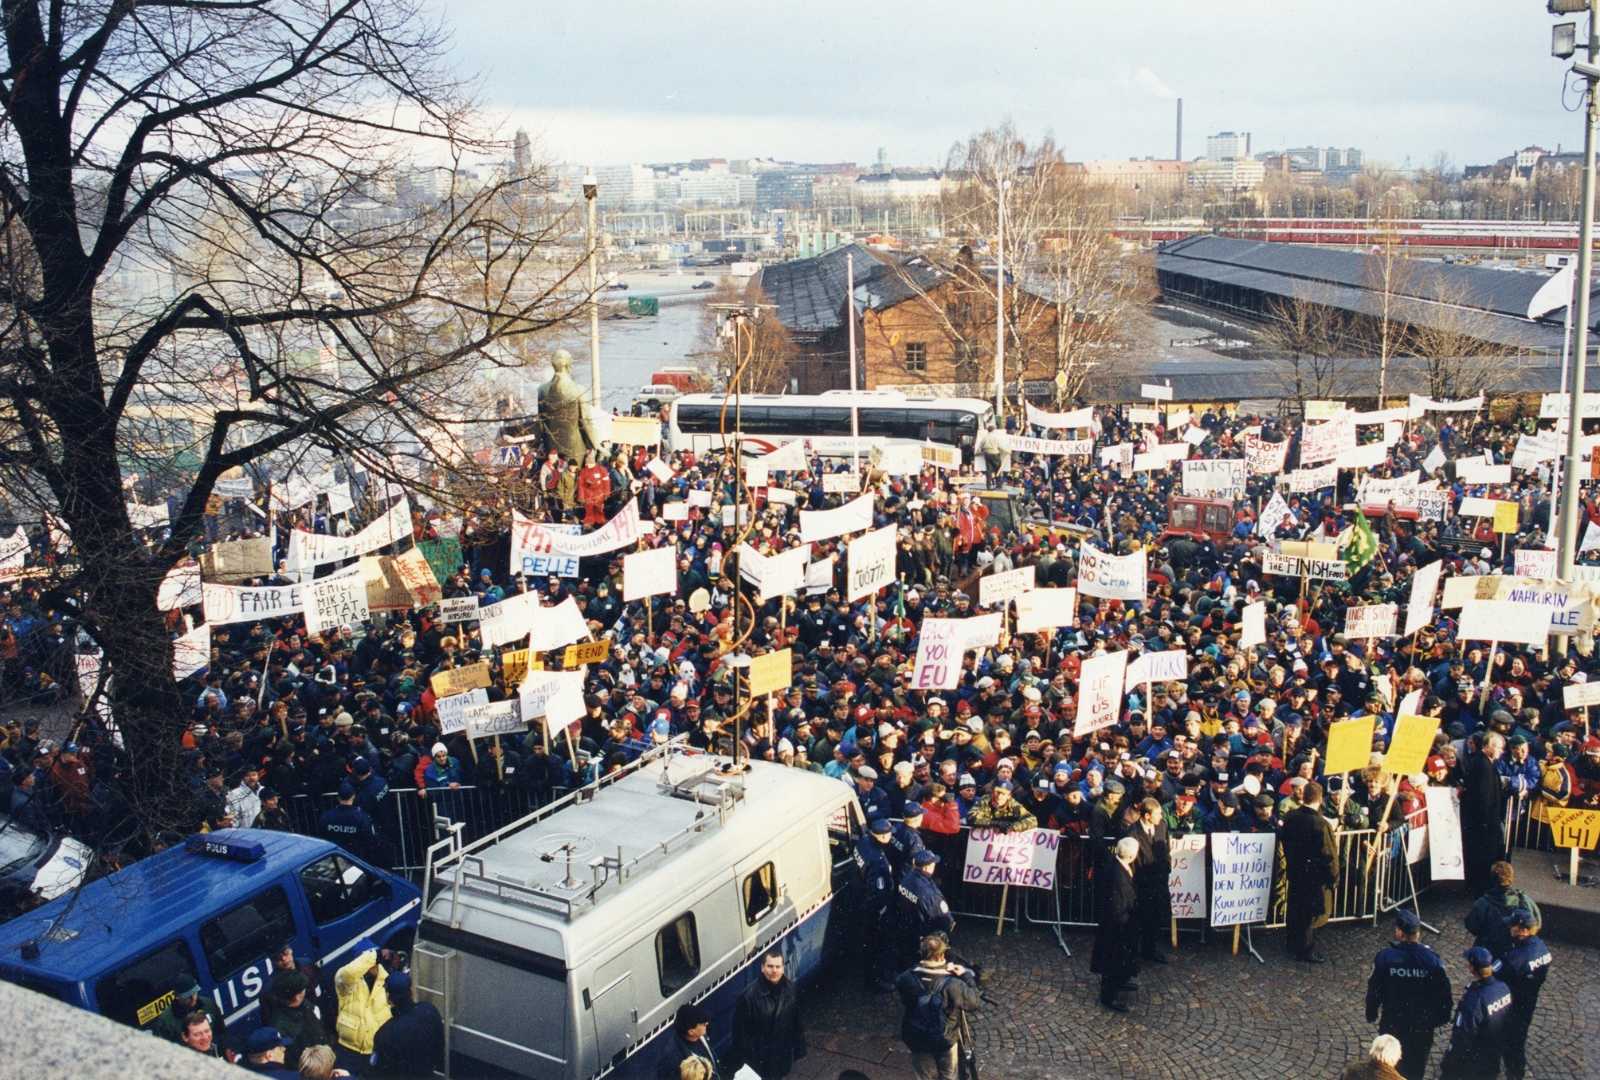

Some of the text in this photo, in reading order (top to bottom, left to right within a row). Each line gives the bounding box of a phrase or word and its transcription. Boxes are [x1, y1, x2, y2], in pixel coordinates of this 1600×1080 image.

[1286, 556, 1329, 578] FINISH
[240, 589, 282, 613] FAIR
[317, 591, 352, 609] MIKSI
[918, 664, 948, 688] EU
[1560, 826, 1591, 848] 141
[983, 843, 1030, 864] LIES
[964, 863, 1053, 888] TO FARMERS
